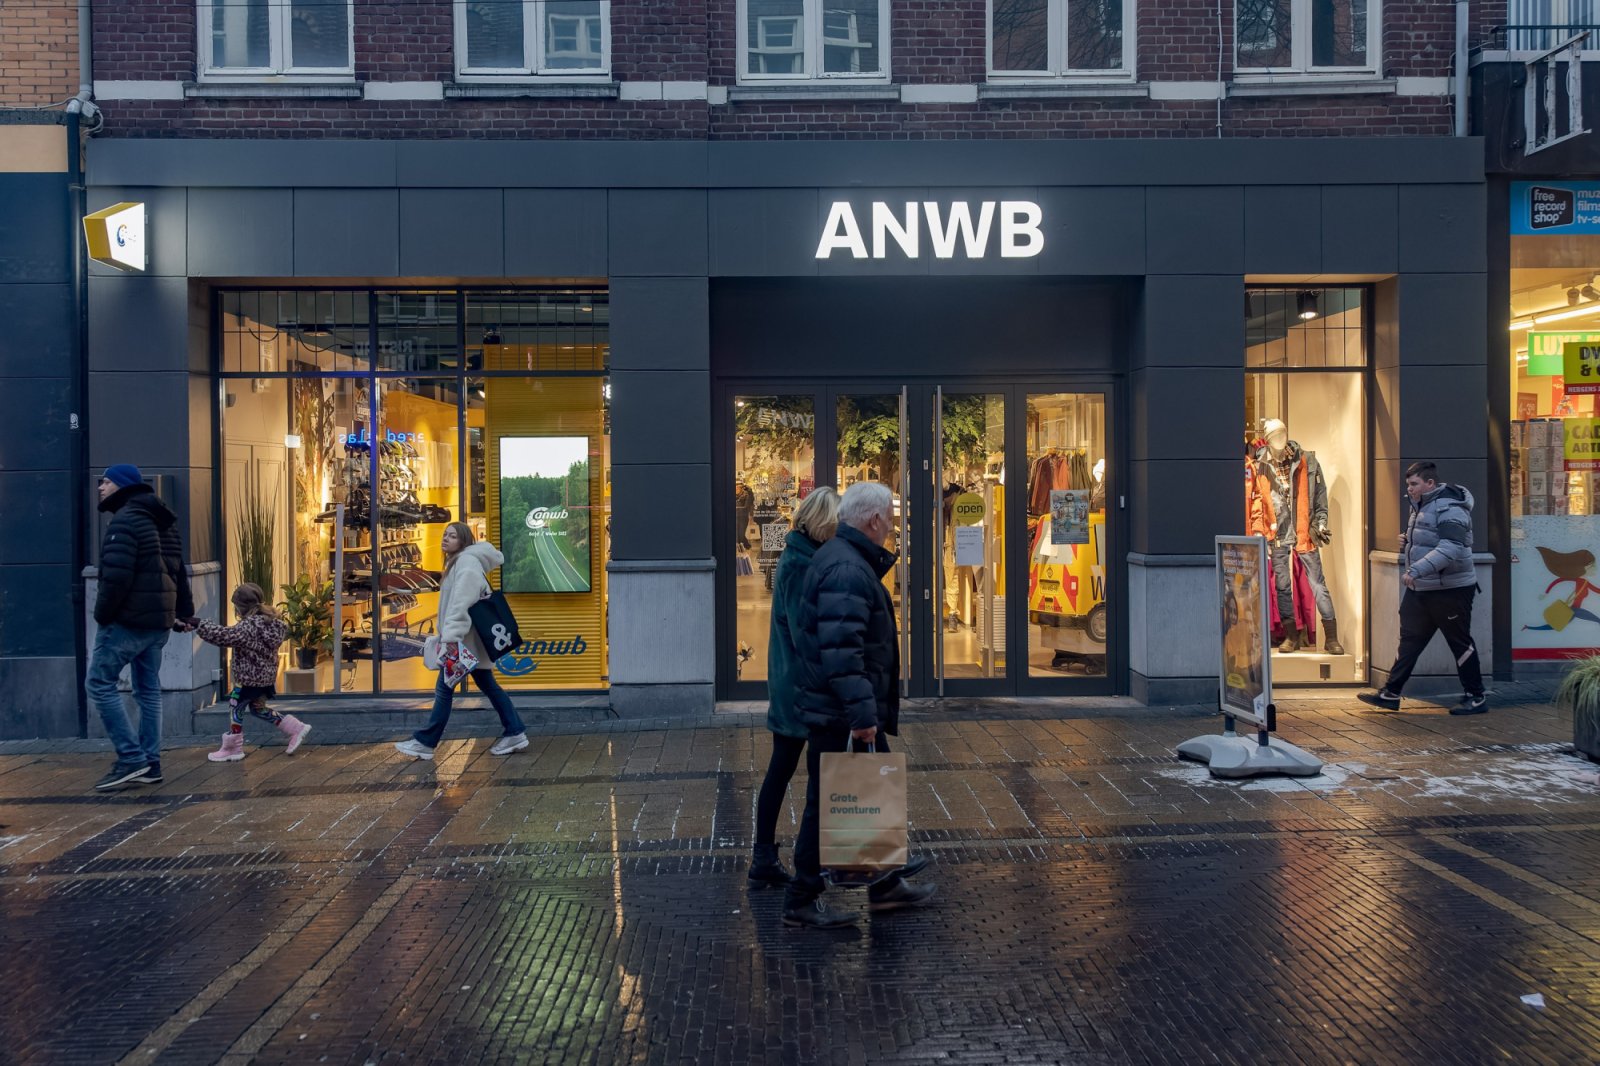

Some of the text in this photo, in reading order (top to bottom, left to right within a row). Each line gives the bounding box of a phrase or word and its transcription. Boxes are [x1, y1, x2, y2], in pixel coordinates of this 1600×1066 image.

[1534, 189, 1555, 201] free
[1534, 201, 1566, 211] record
[815, 201, 1045, 258] ANWB
[1580, 364, 1592, 377] &
[534, 509, 569, 519] anwb
[957, 505, 983, 515] open
[491, 623, 512, 651] &
[514, 635, 587, 655] anwb
[830, 793, 858, 802] Grote
[830, 806, 881, 814] avonturen
